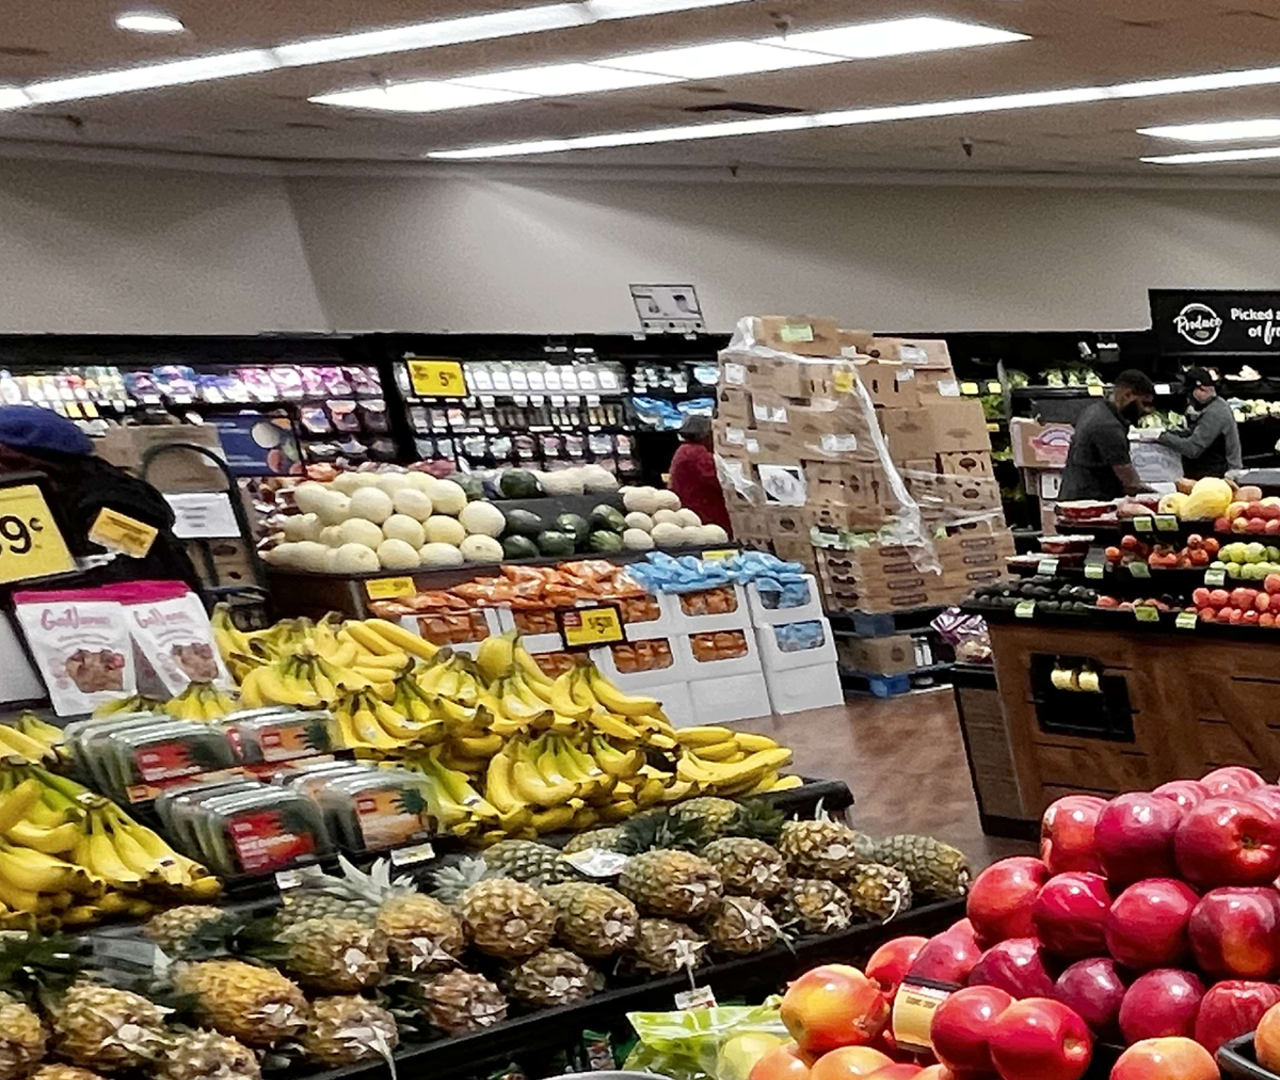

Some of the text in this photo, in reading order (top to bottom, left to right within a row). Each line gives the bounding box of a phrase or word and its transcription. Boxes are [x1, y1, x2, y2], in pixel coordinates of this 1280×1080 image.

[1231, 308, 1273, 320] Picked
[1173, 315, 1222, 333] Produce
[1248, 325, 1262, 337] of
